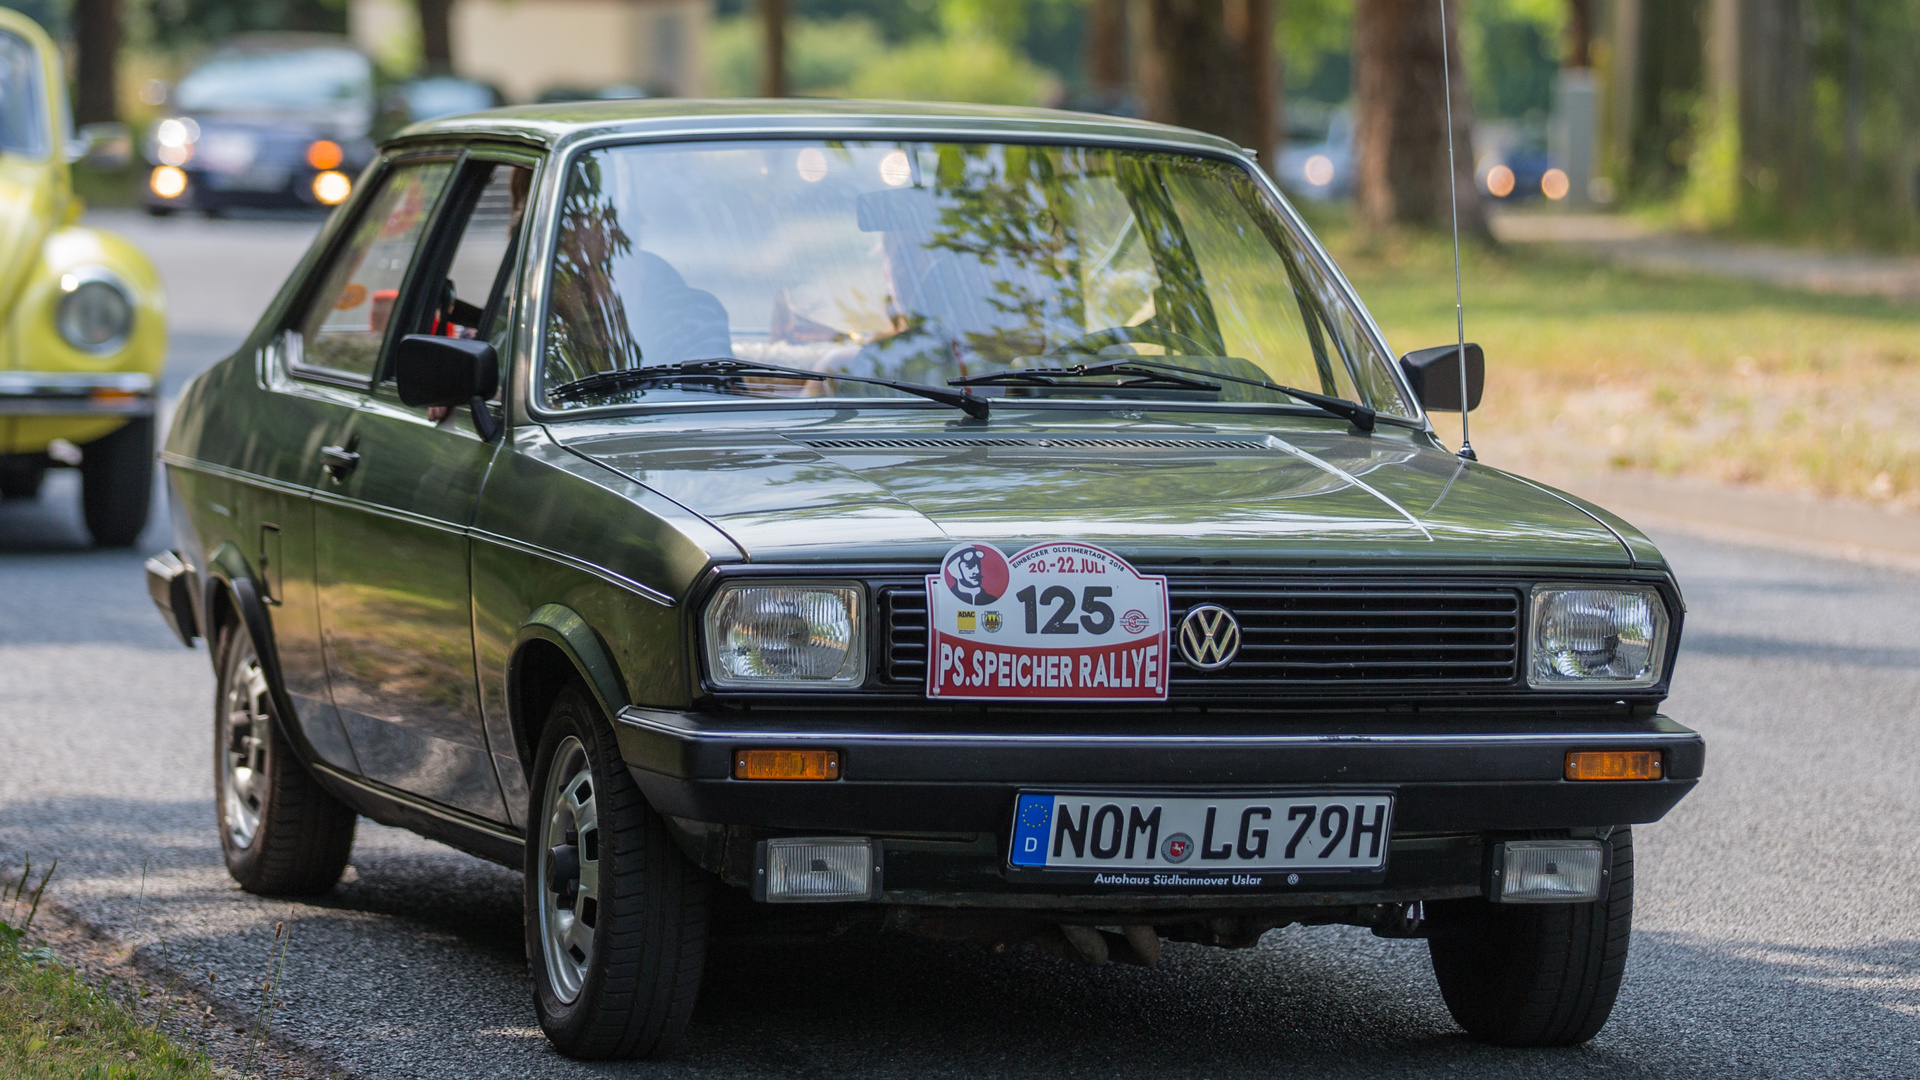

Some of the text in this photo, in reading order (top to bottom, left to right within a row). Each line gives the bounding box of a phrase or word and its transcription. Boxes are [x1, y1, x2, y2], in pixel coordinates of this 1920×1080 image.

[1012, 547, 1125, 573] EINBECKER OLDTIMERTAGE 2018
[1016, 585, 1114, 635] 125
[1181, 606, 1239, 667] VW
[939, 643, 1159, 688] PS.SPEICHER RALLYE
[1024, 838, 1038, 853] D
[1052, 803, 1386, 860] NOM LG 79H
[1094, 873, 1262, 886] Autohaus Südhannover Uslar
